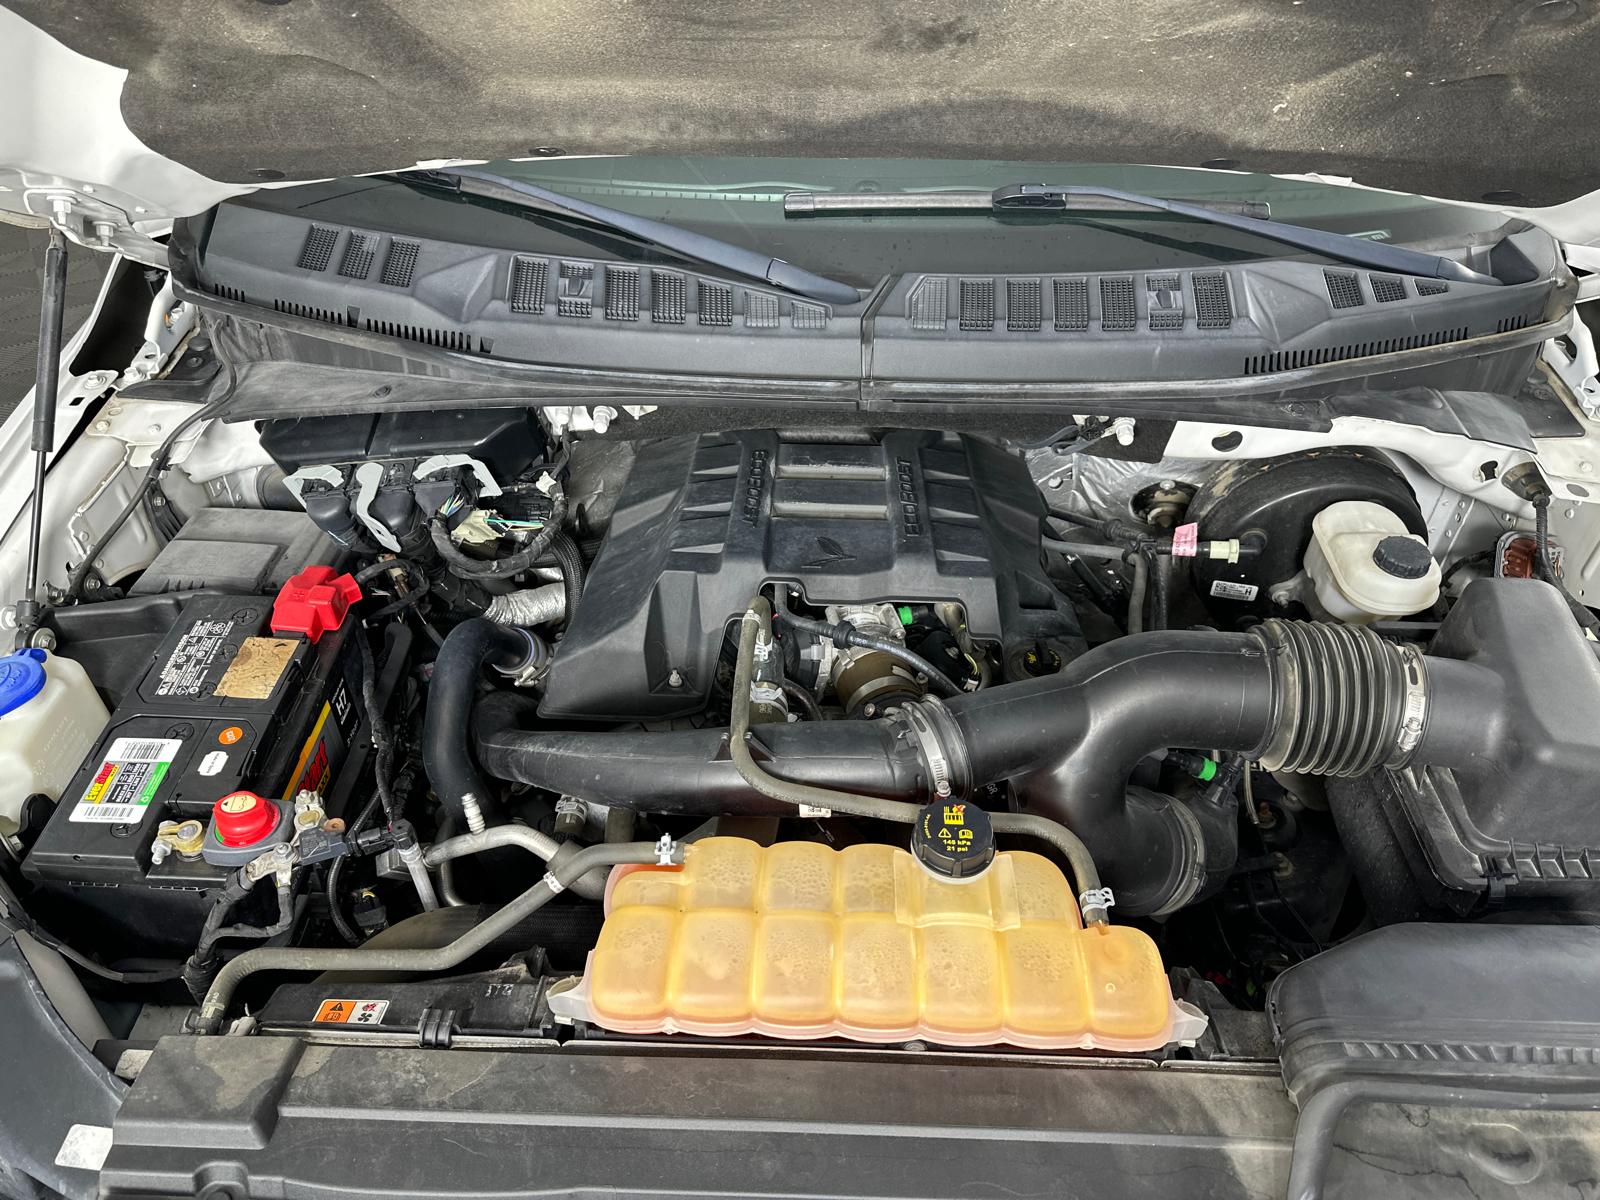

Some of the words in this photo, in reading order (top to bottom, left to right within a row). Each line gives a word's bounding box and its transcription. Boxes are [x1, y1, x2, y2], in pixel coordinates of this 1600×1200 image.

[742, 450, 769, 528] ECOBOOST
[895, 456, 922, 537] ECOBOOST
[335, 687, 347, 716] H7
[84, 762, 116, 801] EverStart
